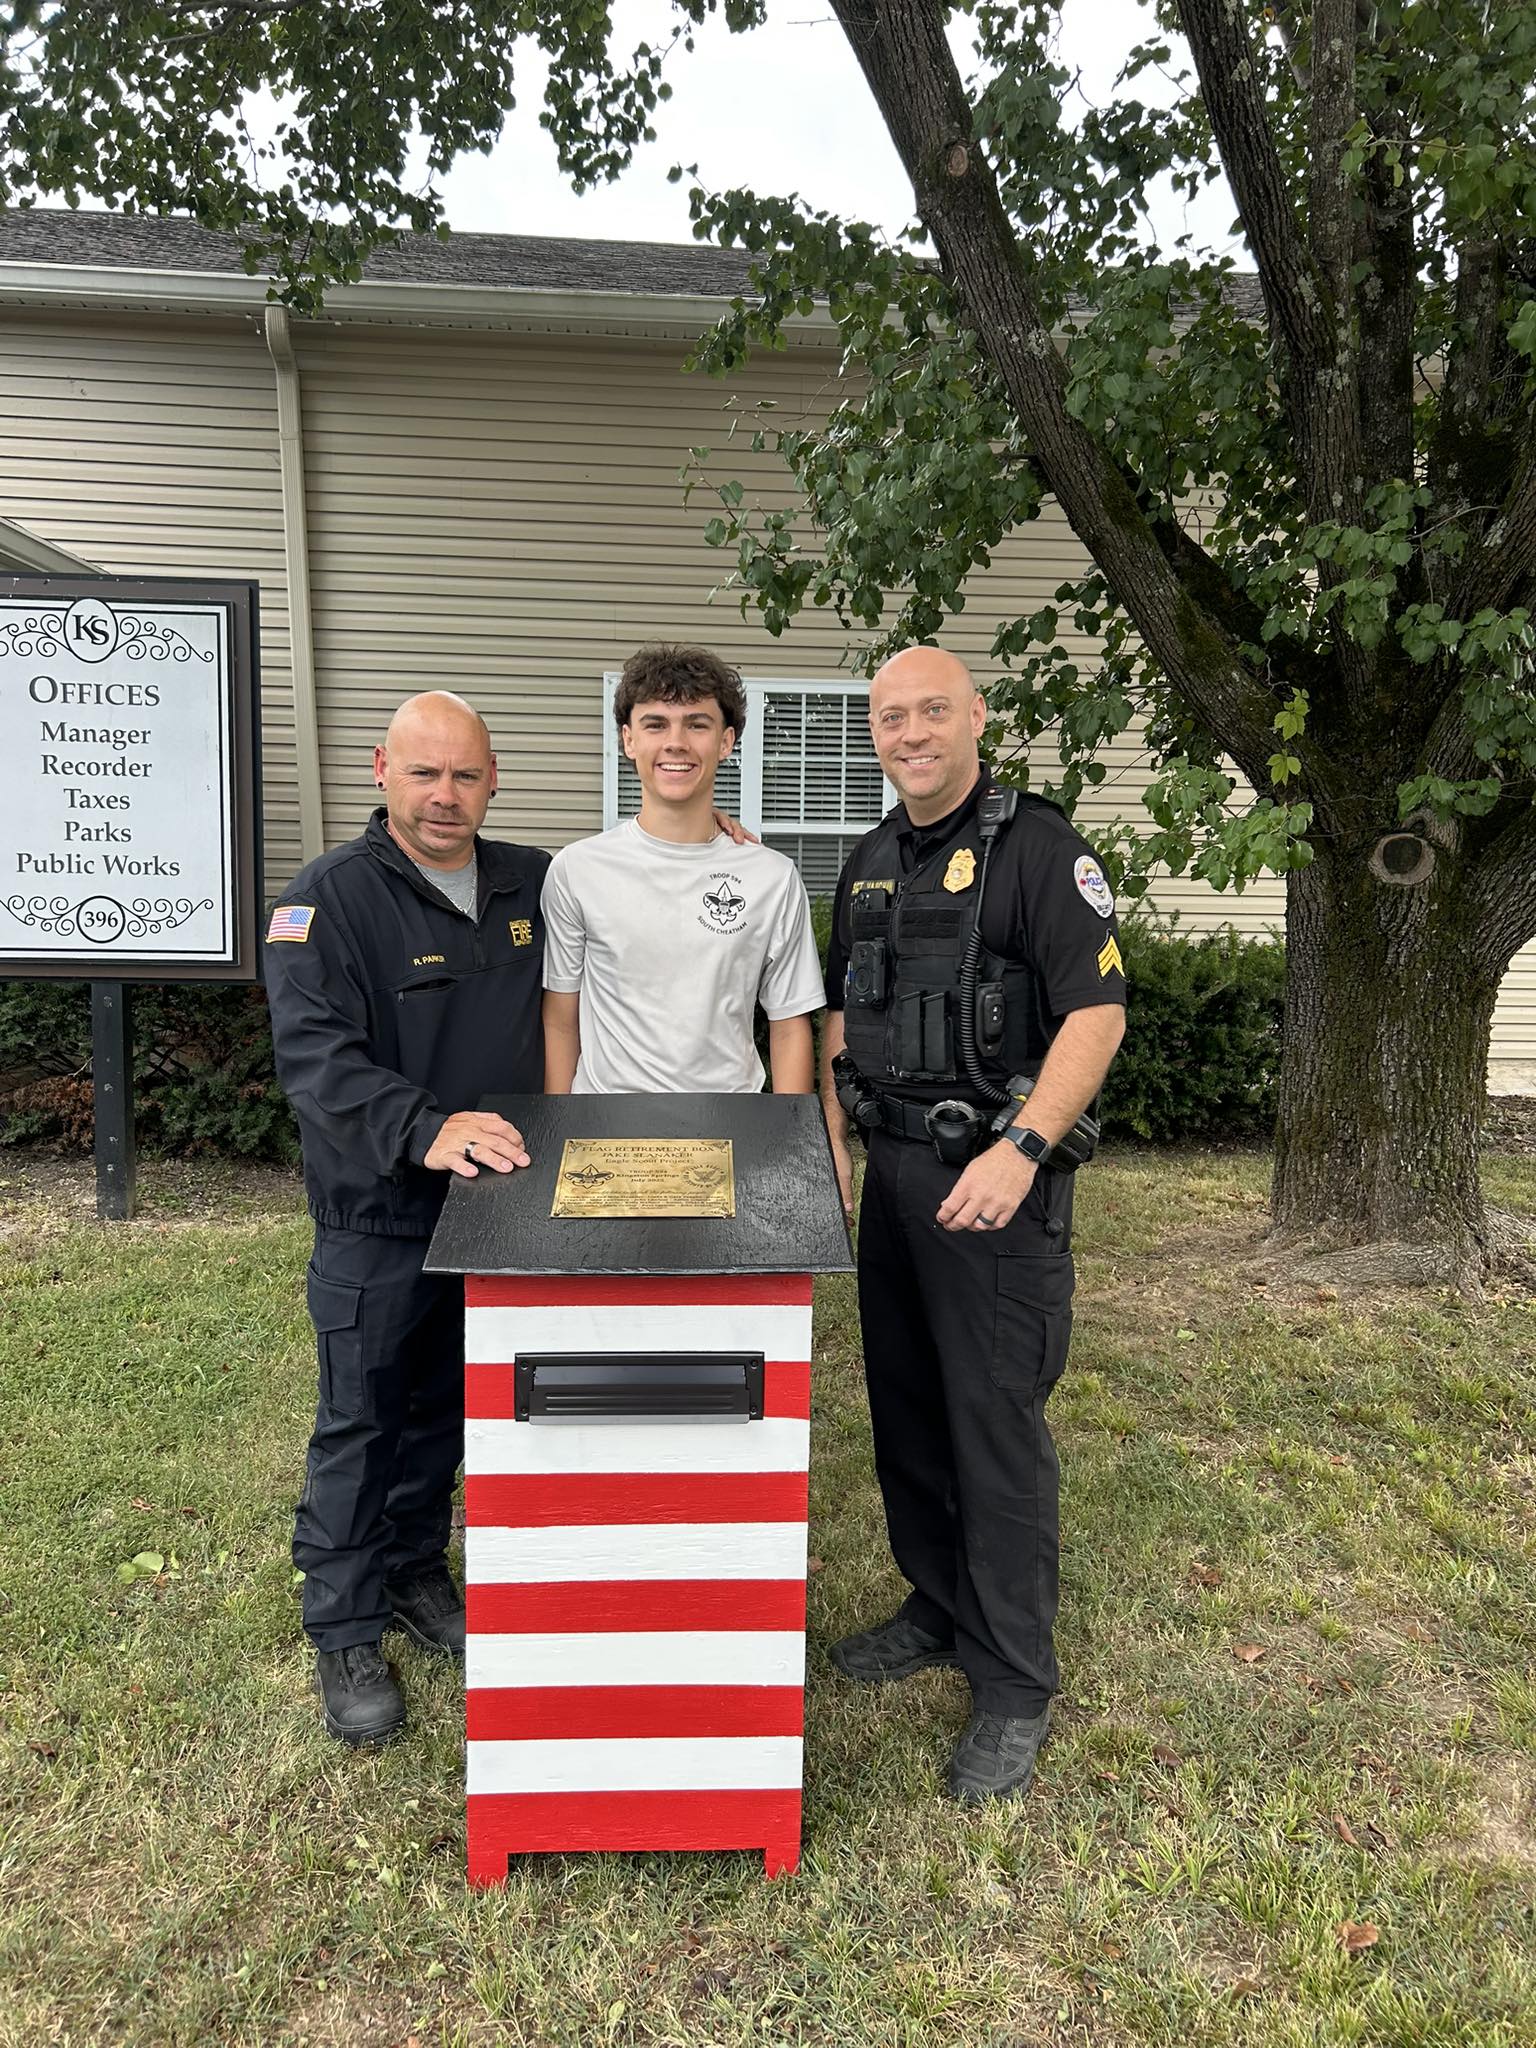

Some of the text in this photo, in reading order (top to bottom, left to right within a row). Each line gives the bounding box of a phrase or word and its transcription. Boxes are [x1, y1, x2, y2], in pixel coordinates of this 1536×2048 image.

[73, 613, 110, 646] KS
[40, 720, 151, 751] Manager
[41, 754, 153, 777] Recorder
[63, 788, 131, 810] Taxes
[63, 820, 132, 842] Parks
[16, 852, 181, 877] Public Works
[709, 872, 730, 880] TROOP
[83, 911, 119, 929] 396
[697, 915, 716, 932] SOUTH
